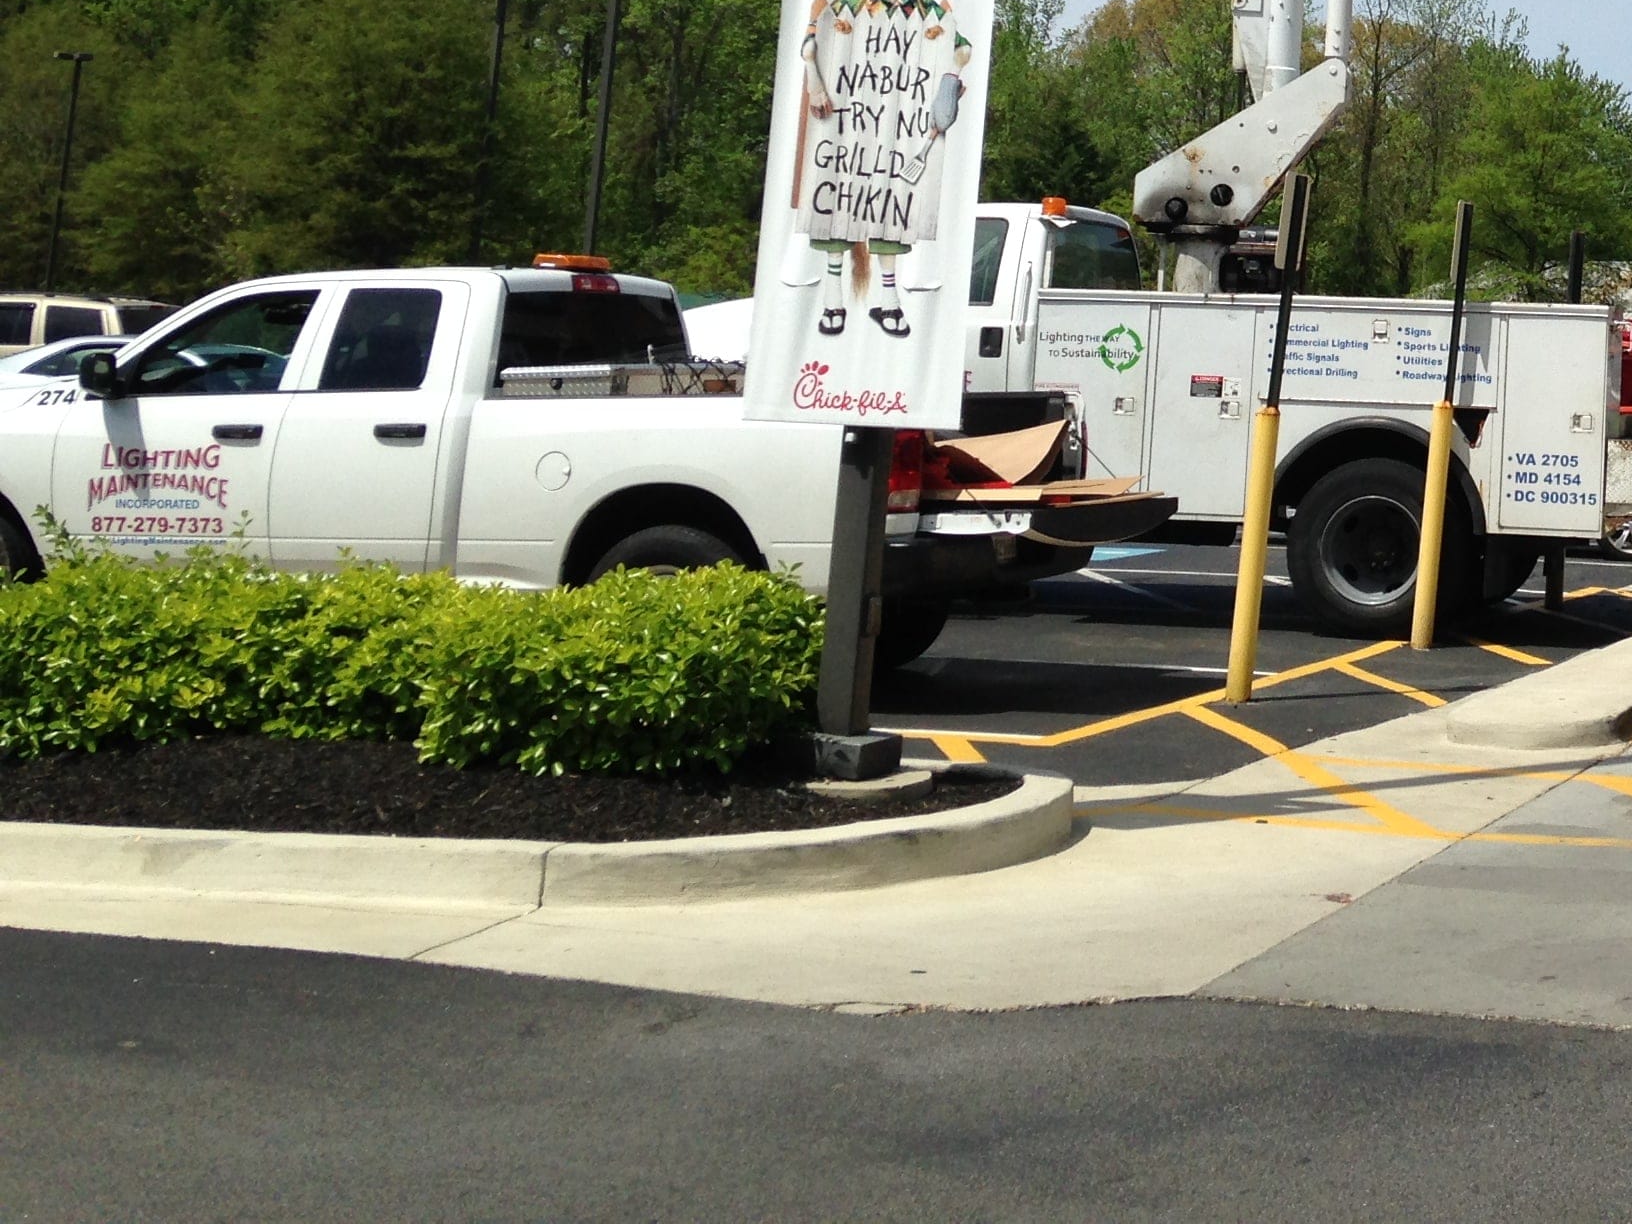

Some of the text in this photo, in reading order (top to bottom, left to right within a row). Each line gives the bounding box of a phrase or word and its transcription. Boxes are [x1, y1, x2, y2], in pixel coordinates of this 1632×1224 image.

[865, 24, 917, 65] HAY
[836, 60, 930, 105] NABUR
[832, 101, 930, 140] TRY NU
[814, 139, 905, 179] GRILLD
[812, 180, 914, 231] CHIKIN
[1039, 331, 1084, 344] Lighting
[1086, 335, 1100, 343] THE
[1404, 327, 1432, 337] Signs
[1331, 339, 1369, 350] Lighting
[1403, 341, 1437, 352] Sports
[1049, 349, 1060, 357] TO
[1306, 353, 1340, 363] Signals
[1403, 355, 1443, 366] Utilities
[1325, 367, 1358, 379] Drilling
[1455, 372, 1492, 384] ighting
[37, 389, 76, 406] 274
[793, 372, 908, 416] Chick-fil-A
[101, 443, 221, 470] LIGHTING
[1515, 453, 1579, 467] VA 2705
[1515, 471, 1582, 486] MD 4154
[87, 473, 230, 512] MAINTENANCE
[1514, 490, 1597, 506] DC 900315
[115, 498, 200, 510] INCORPORATED
[91, 516, 224, 534] 877-279-7373
